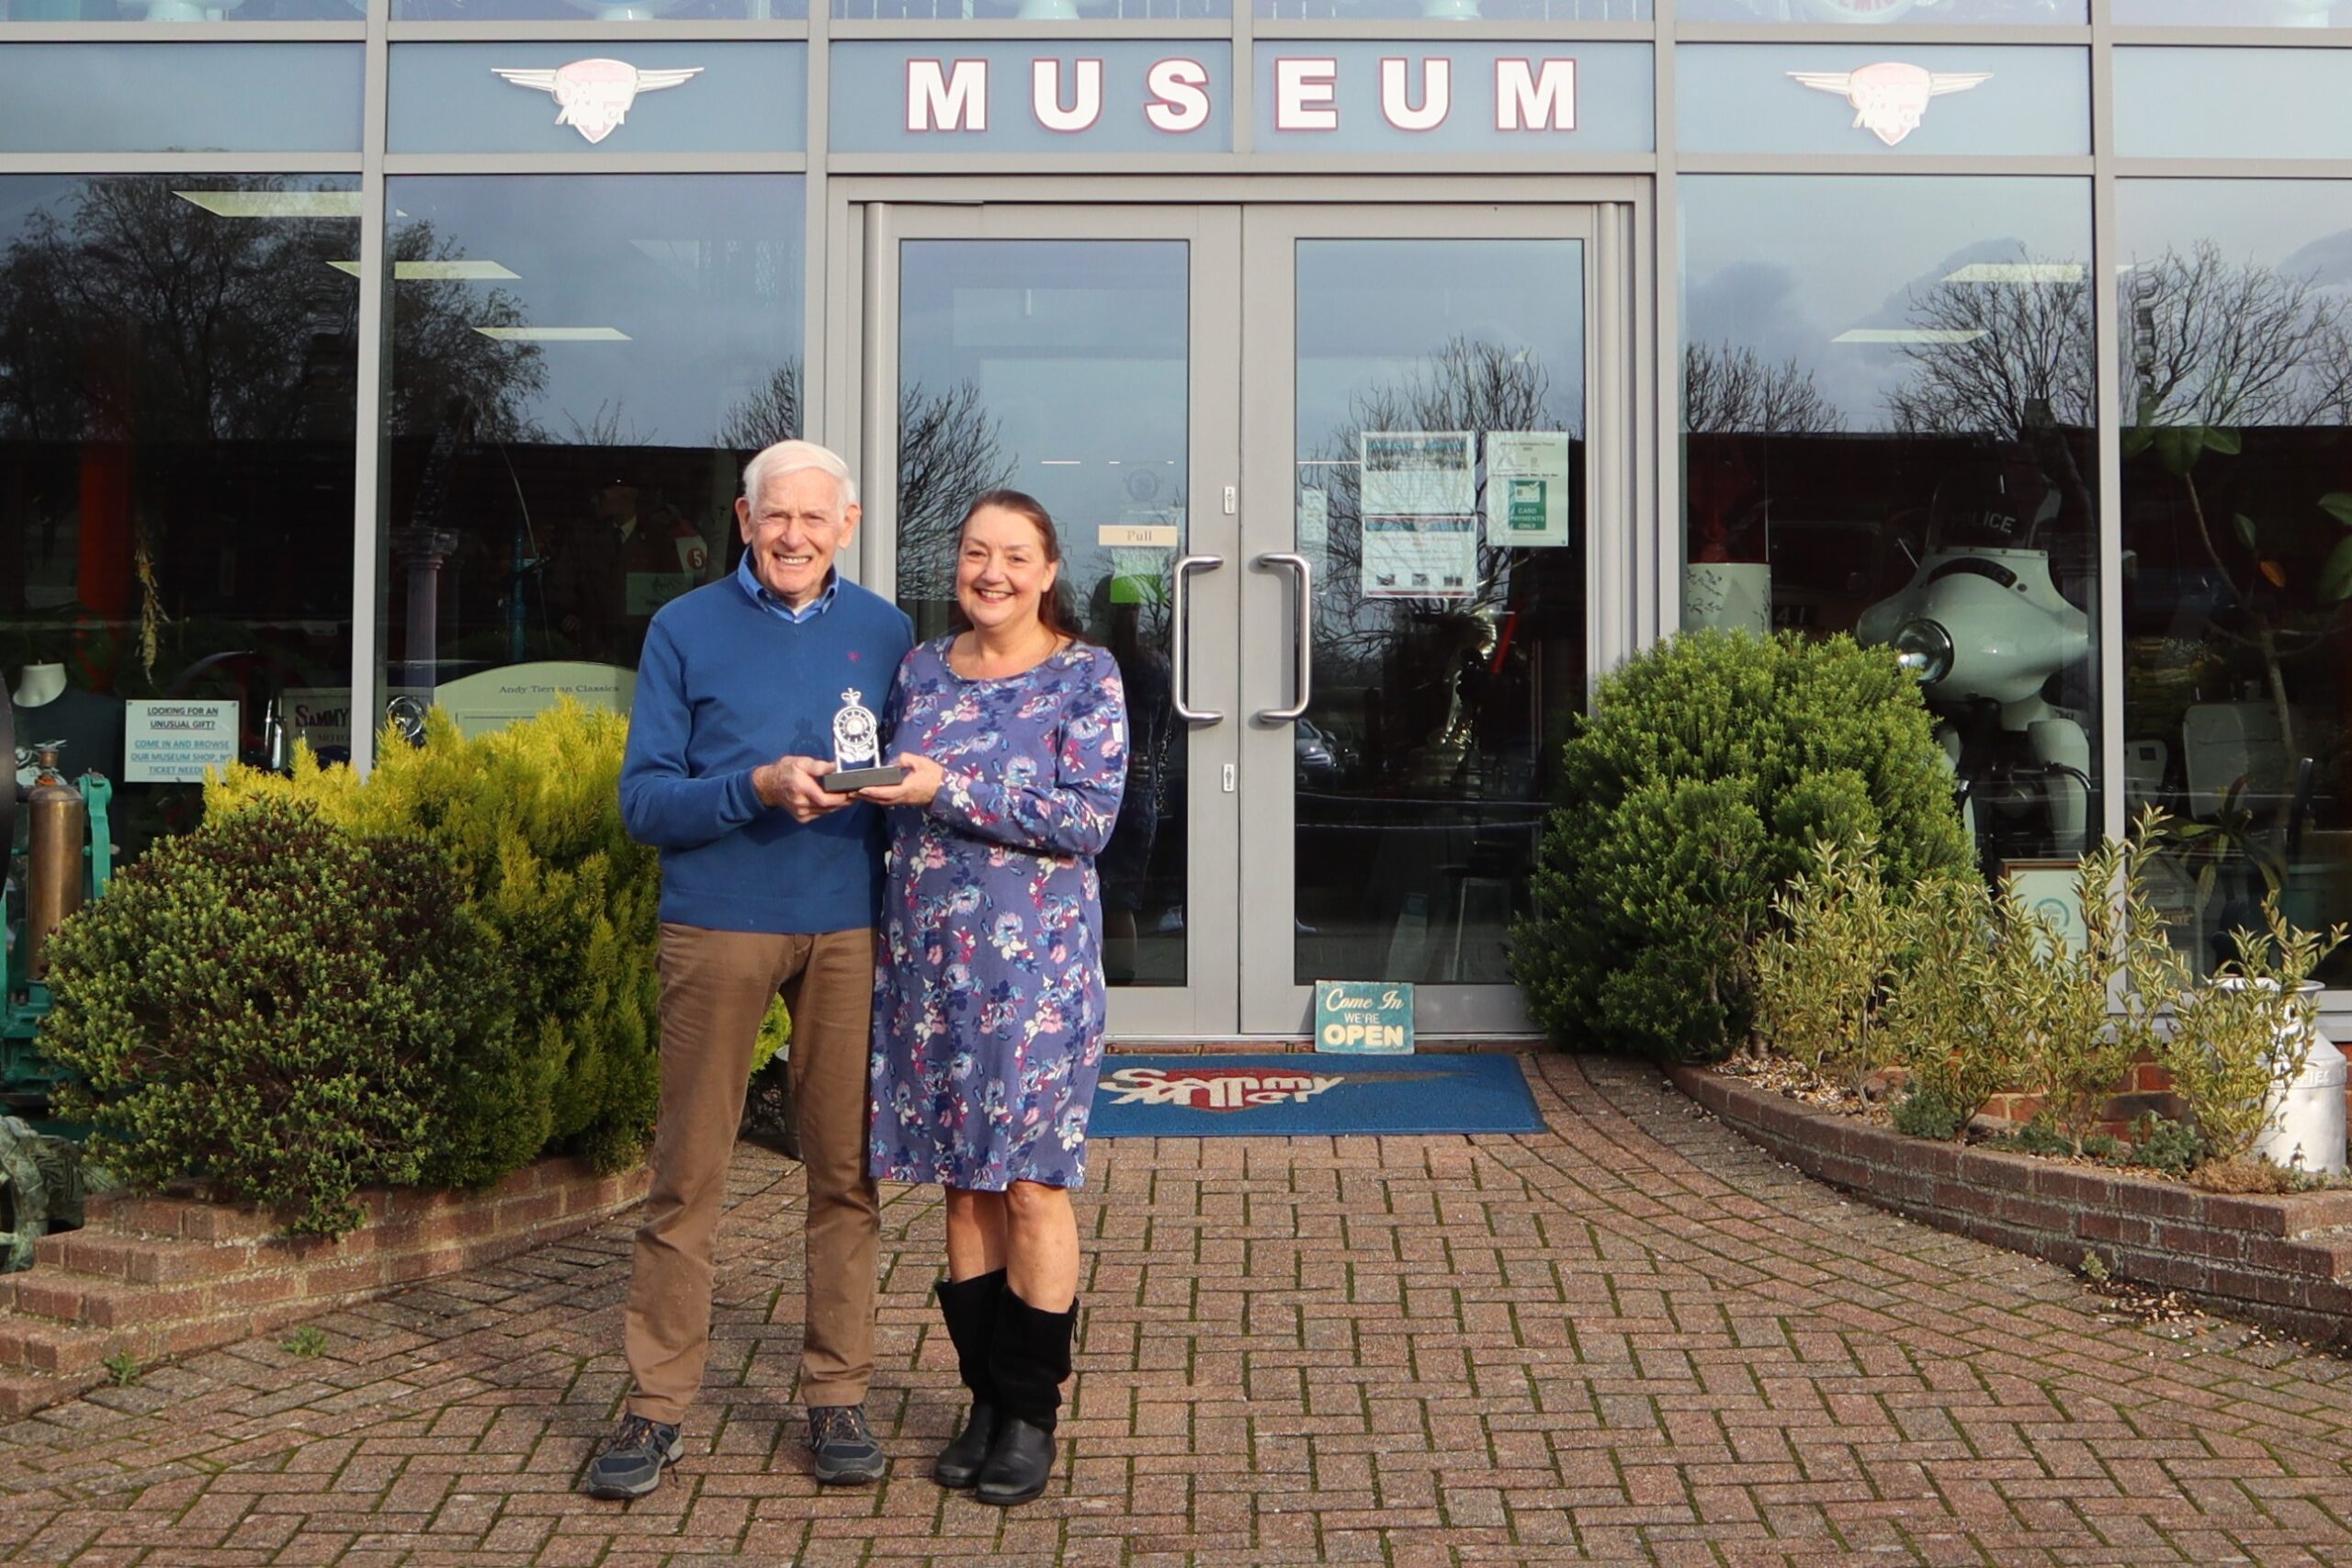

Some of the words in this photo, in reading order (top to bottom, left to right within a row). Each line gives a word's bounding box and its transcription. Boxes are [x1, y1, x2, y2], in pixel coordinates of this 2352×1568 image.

[904, 57, 1577, 133] MUSEUM
[1127, 530, 1152, 542] Pull
[694, 549, 702, 568] 5
[499, 685, 528, 694] Andy
[575, 684, 620, 693] Classics
[147, 706, 186, 716] LOOKING
[187, 706, 204, 716] FOR
[205, 706, 219, 716] AN
[150, 720, 190, 728] UNUSUAL
[192, 720, 215, 728] GIFT?
[134, 739, 160, 749] COME
[161, 739, 171, 749] IN
[173, 739, 192, 749] AND
[193, 740, 230, 750] BROWSE
[130, 753, 149, 761] OUR
[151, 753, 191, 761] MUSEUM
[148, 766, 177, 774] TICKET
[1326, 987, 1374, 1012] Come
[1377, 989, 1405, 1010] In
[1343, 1012, 1381, 1024] WE'RE
[1324, 1023, 1404, 1047] OPEN
